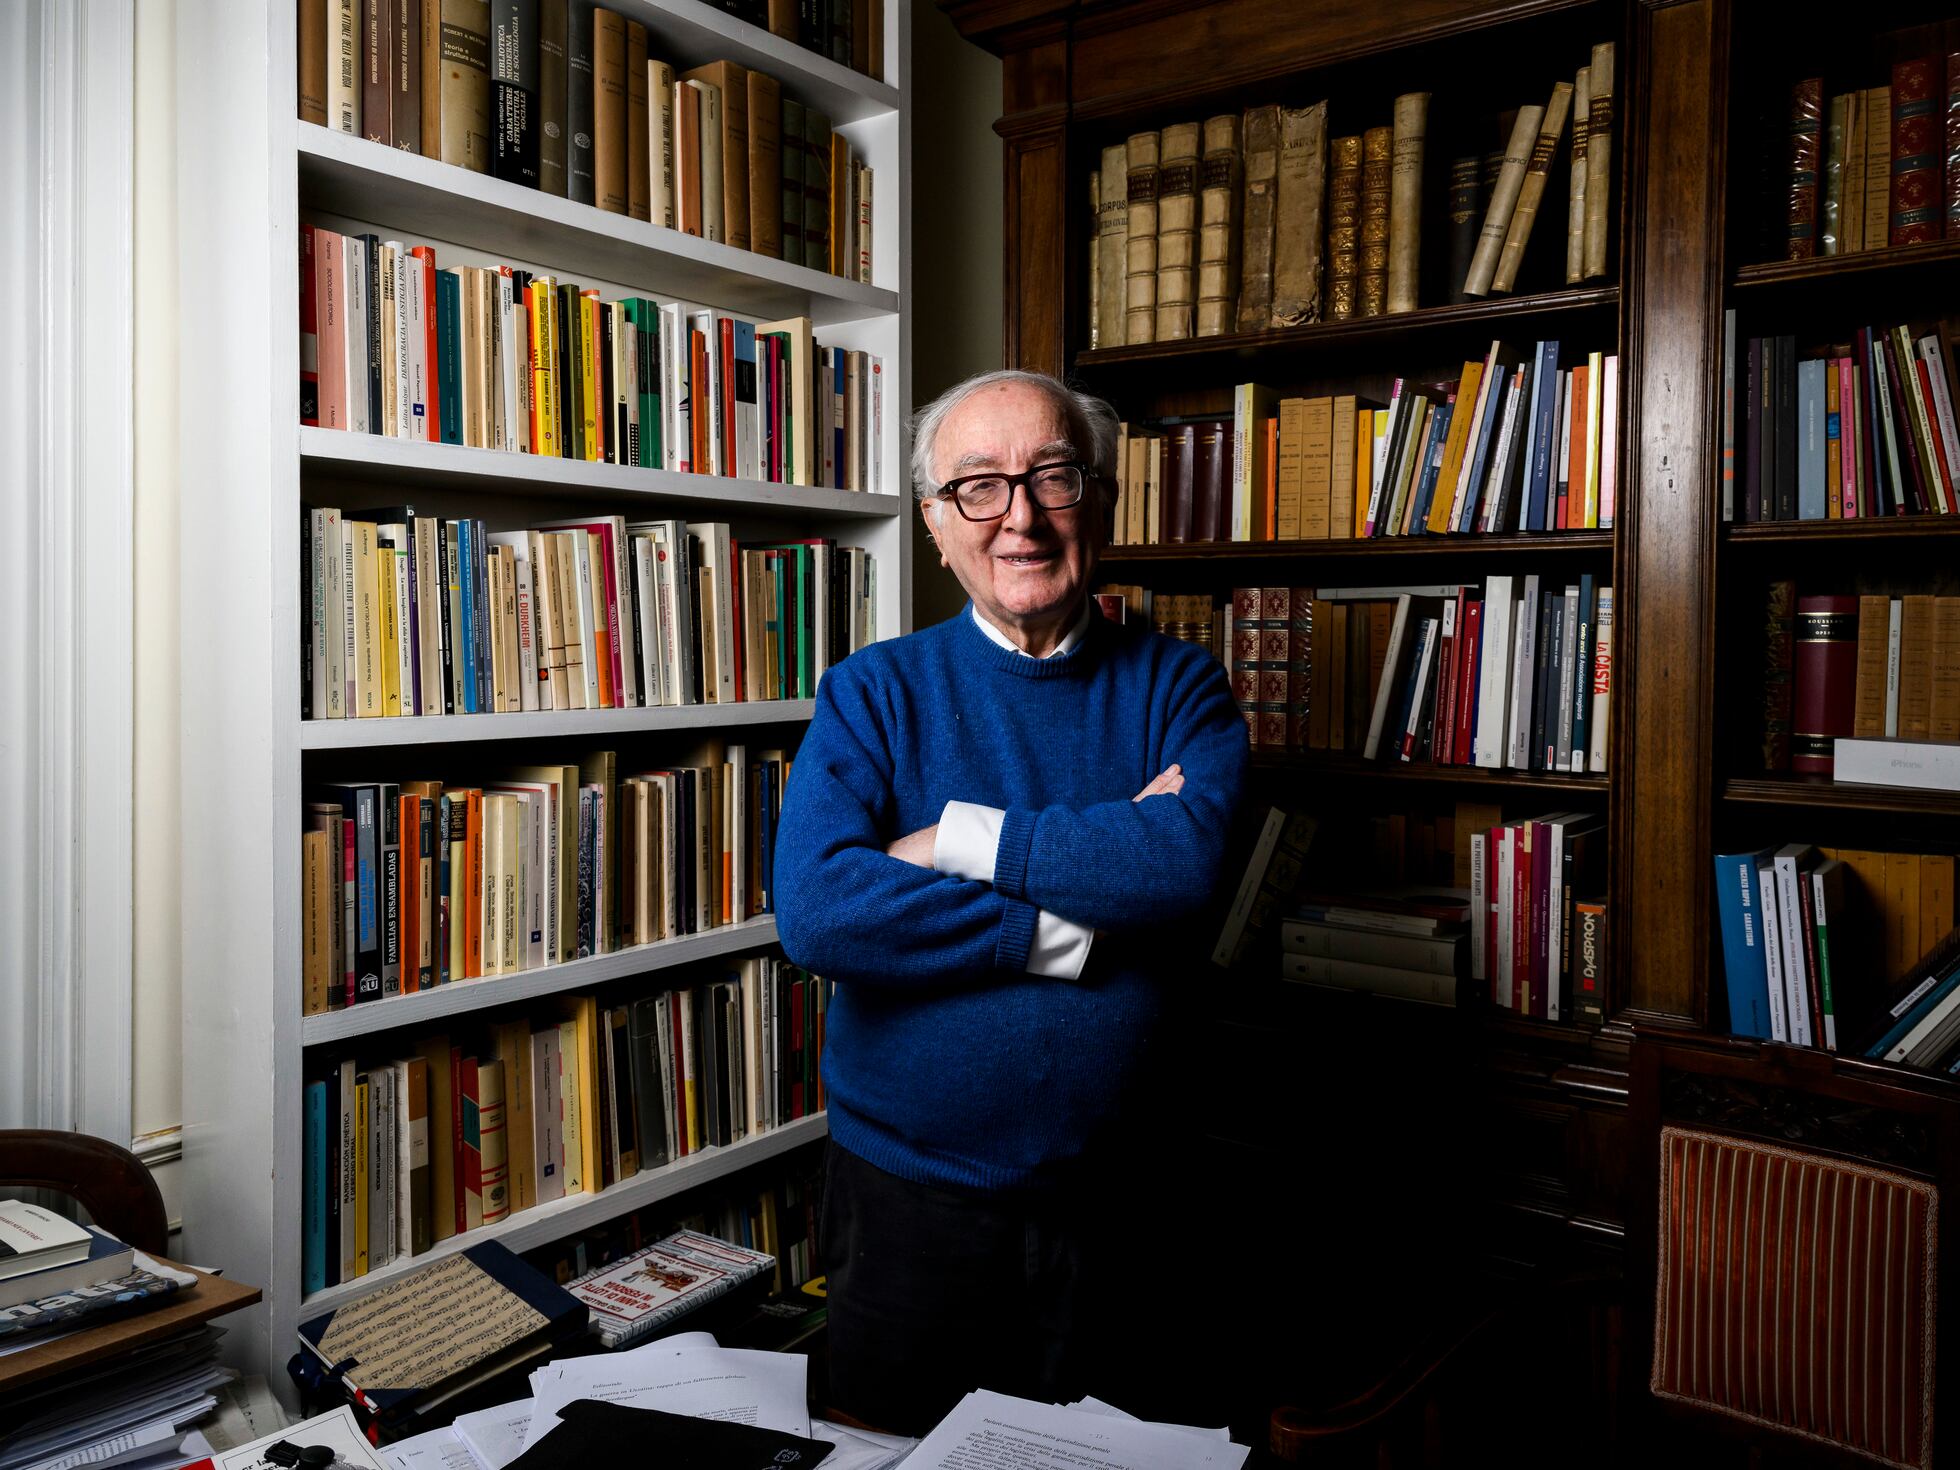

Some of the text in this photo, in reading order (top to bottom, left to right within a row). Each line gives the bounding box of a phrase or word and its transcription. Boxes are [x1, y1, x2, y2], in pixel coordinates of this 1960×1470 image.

[342, 15, 352, 37] ATTUALE
[444, 27, 463, 37] ROBERT
[342, 39, 352, 55] DELLA
[444, 42, 463, 53] Teoria
[342, 58, 352, 89] SOCIOLOGIA
[1099, 199, 1126, 213] CORPUS
[520, 593, 530, 649] E. DURKHEIM
[1577, 660, 1585, 693] Associazione
[1594, 641, 1611, 695] LA CASTA
[1575, 694, 1584, 721] magistrati
[388, 852, 397, 964] FAMILIAS ENSAMBLADAS
[581, 1283, 610, 1296] LOTTE
[603, 1281, 642, 1298] FERROVIA
[983, 1429, 998, 1438] Oggi
[1003, 1435, 1026, 1444] modello
